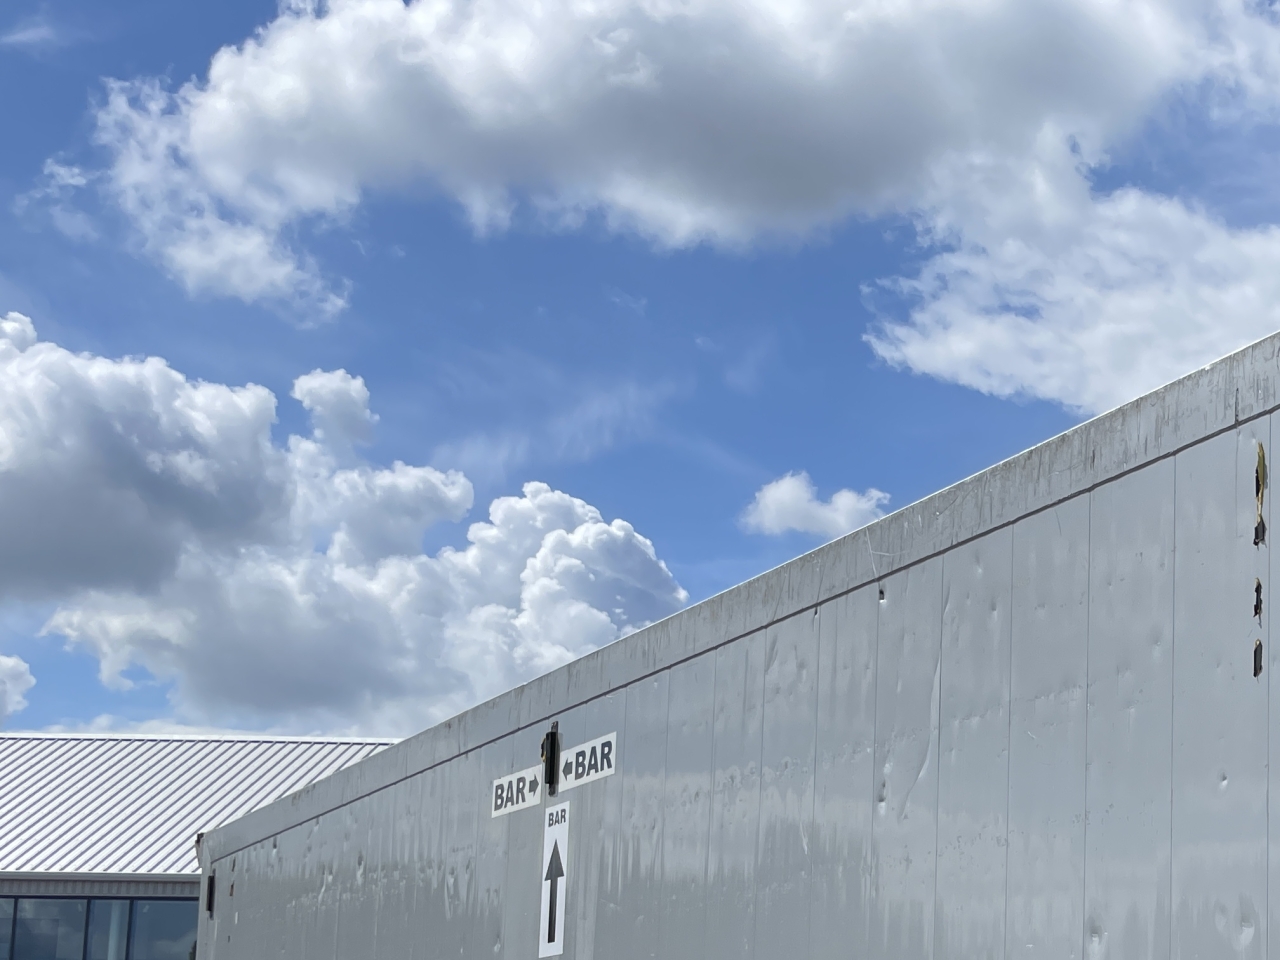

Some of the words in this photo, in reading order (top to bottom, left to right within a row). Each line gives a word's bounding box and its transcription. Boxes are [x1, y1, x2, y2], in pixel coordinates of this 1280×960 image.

[574, 740, 613, 781] BAR
[494, 776, 527, 812] BAR
[548, 808, 567, 828] BAR
